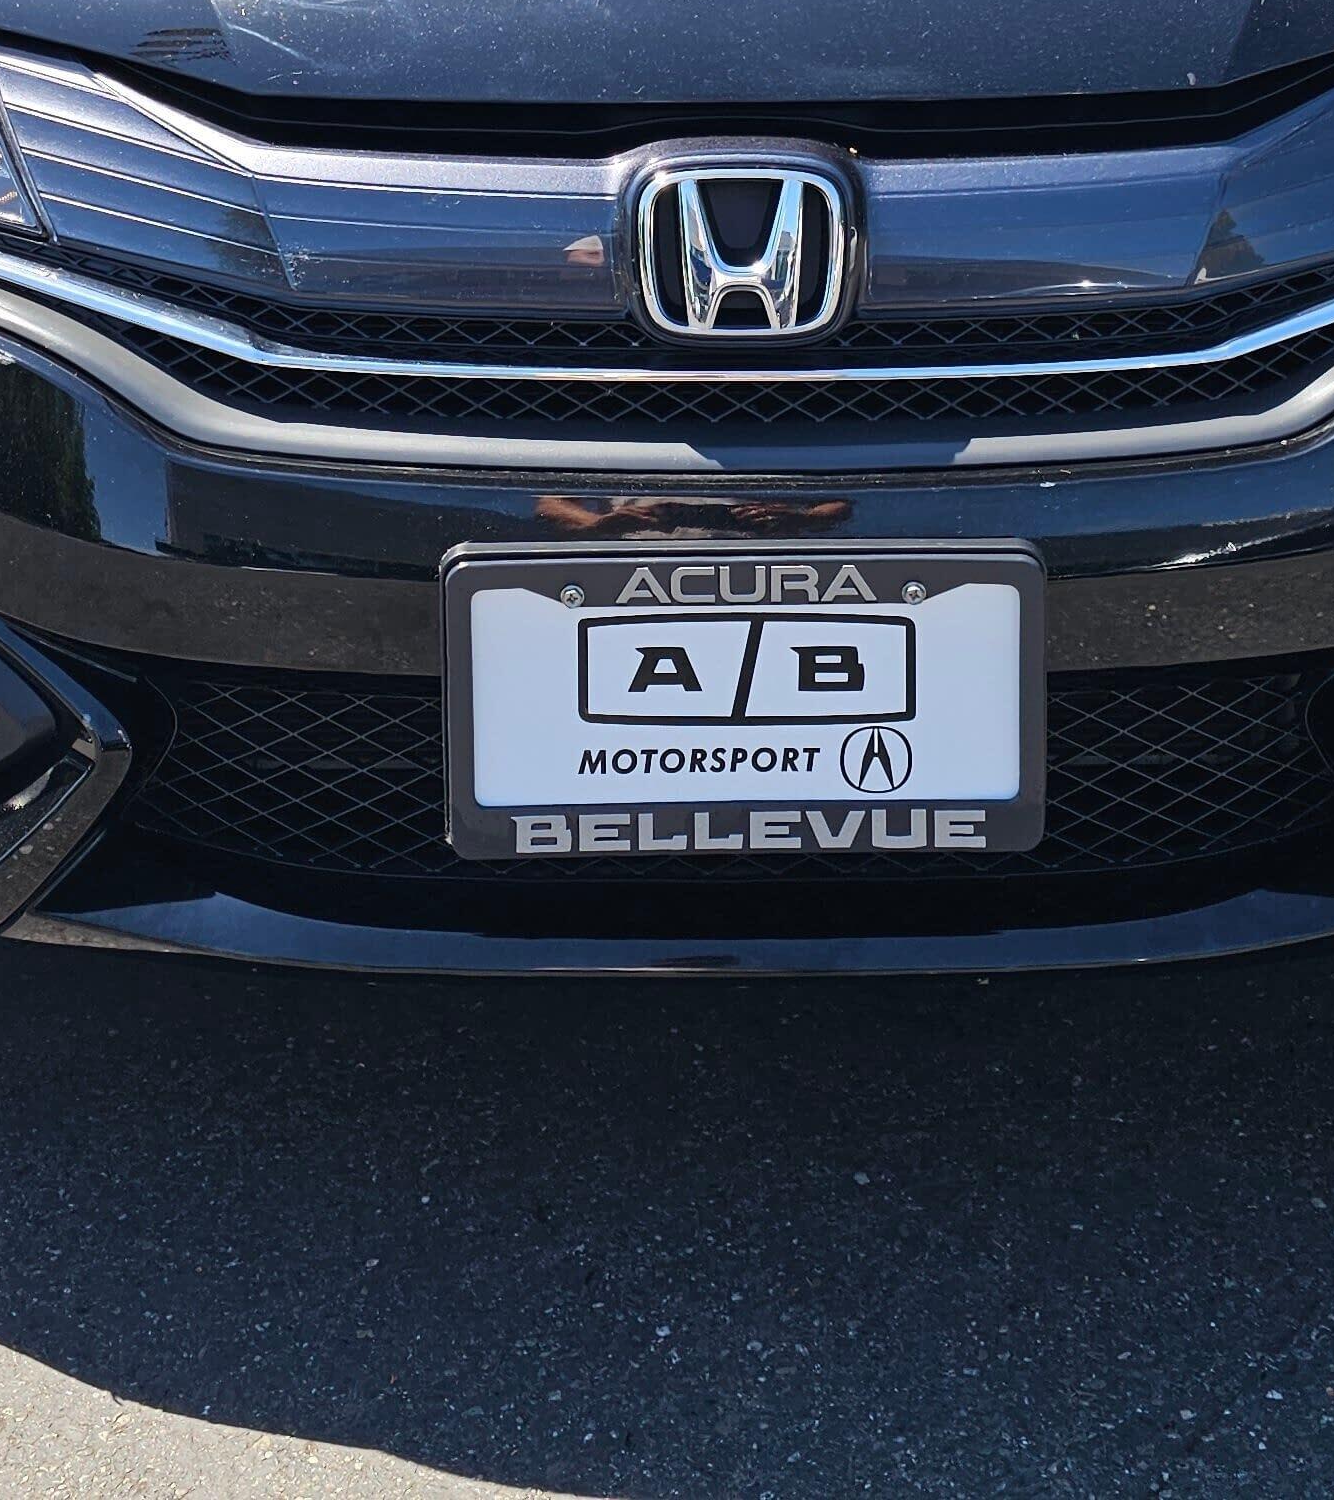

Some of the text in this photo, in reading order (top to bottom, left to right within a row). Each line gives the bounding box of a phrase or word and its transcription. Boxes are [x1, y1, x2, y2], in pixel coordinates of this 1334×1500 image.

[615, 563, 878, 606] ACURA
[627, 645, 865, 693] A B
[578, 746, 821, 776] MOTORSPORT
[510, 807, 987, 855] BELLEVUE
